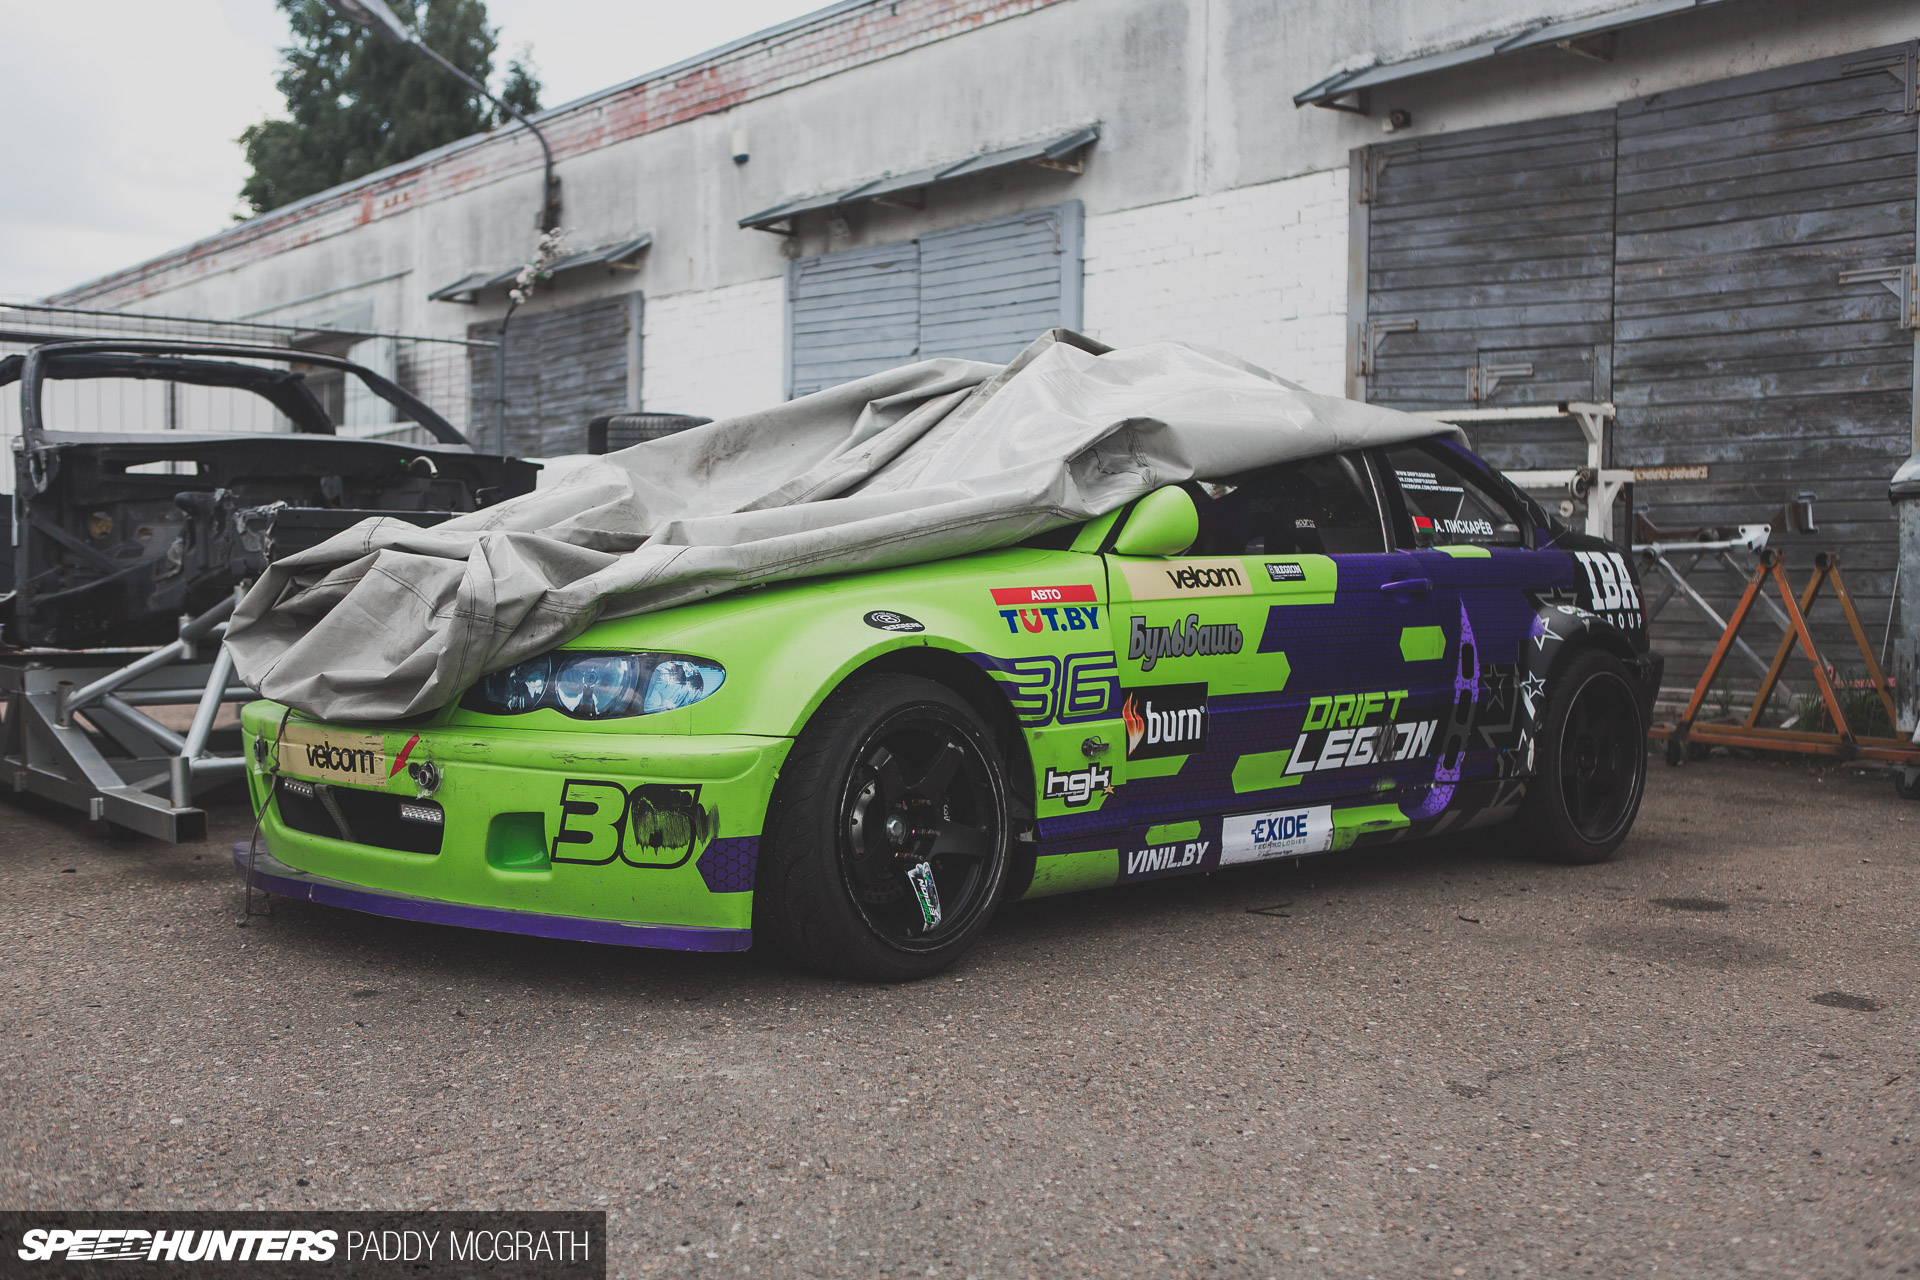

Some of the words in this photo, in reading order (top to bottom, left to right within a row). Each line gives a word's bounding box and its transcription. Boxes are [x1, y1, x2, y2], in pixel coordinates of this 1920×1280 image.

[1434, 518, 1445, 533] А.
[1444, 518, 1494, 536] ПИСКАРЁВ
[1166, 566, 1241, 589] velcom
[1273, 565, 1302, 574] REGION
[1574, 551, 1640, 610] IBA
[1031, 589, 1061, 601] АВТО
[999, 607, 1099, 633] TUT.BY
[1598, 612, 1641, 629] ROUP
[1128, 614, 1243, 672] Бульбашъ
[1012, 651, 1117, 727] 36
[1302, 690, 1408, 731] DRIFT
[306, 741, 374, 774] velcom
[1047, 766, 1109, 802] hgk
[1251, 814, 1308, 843] EXIDE
[1128, 842, 1209, 874] VINIL.BY
[1254, 838, 1307, 850] TECHNOLOGIES
